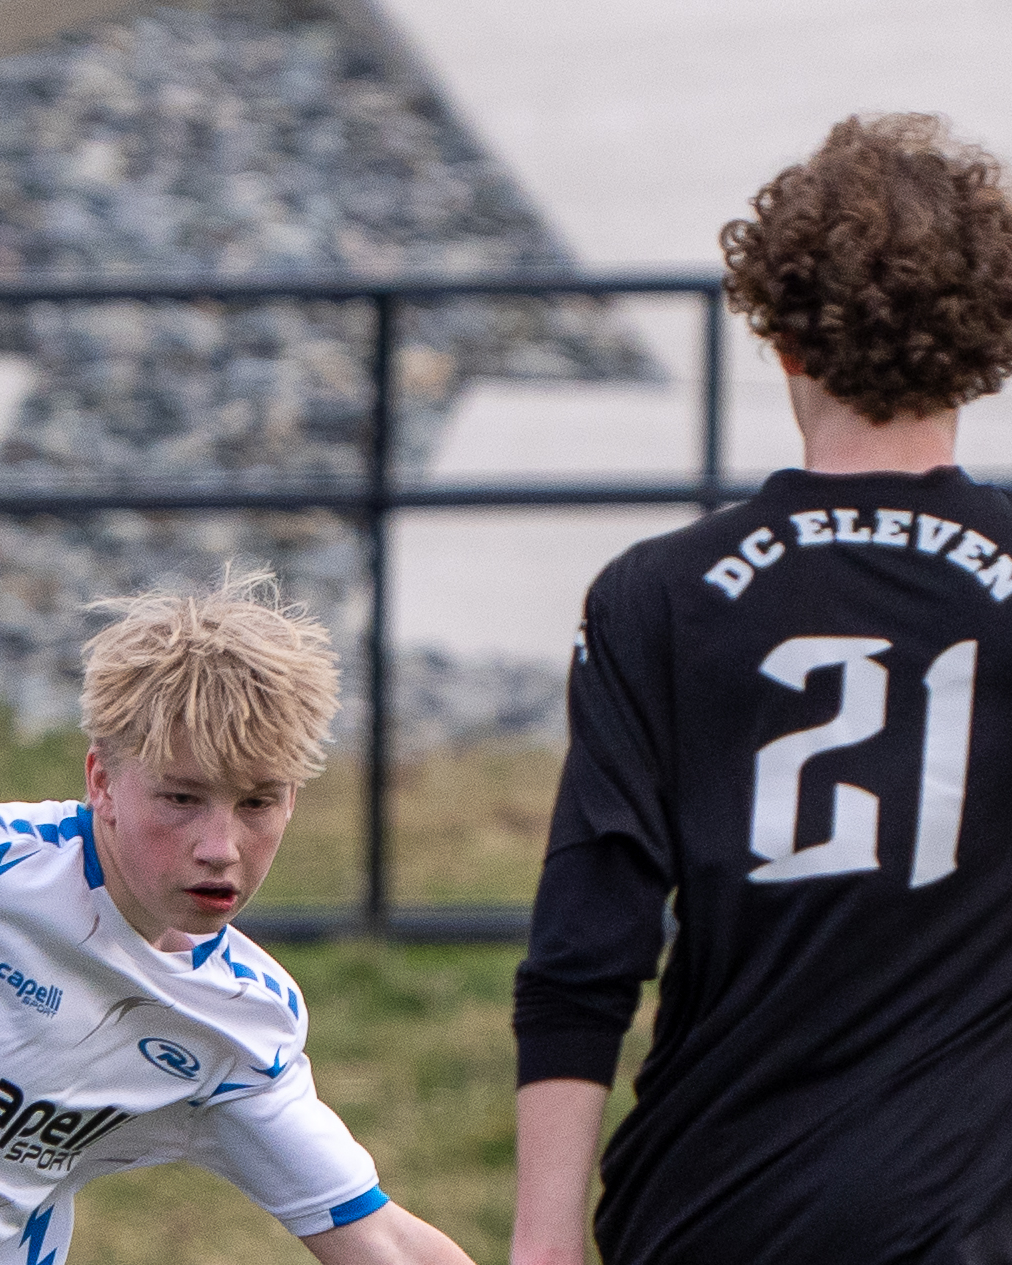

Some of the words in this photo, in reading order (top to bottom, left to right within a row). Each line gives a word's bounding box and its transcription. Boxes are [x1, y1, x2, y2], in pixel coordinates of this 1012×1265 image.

[702, 526, 786, 600] DC
[789, 507, 1012, 602] ELEVEN
[746, 635, 979, 890] 21
[4, 1141, 82, 1172] SPORT
